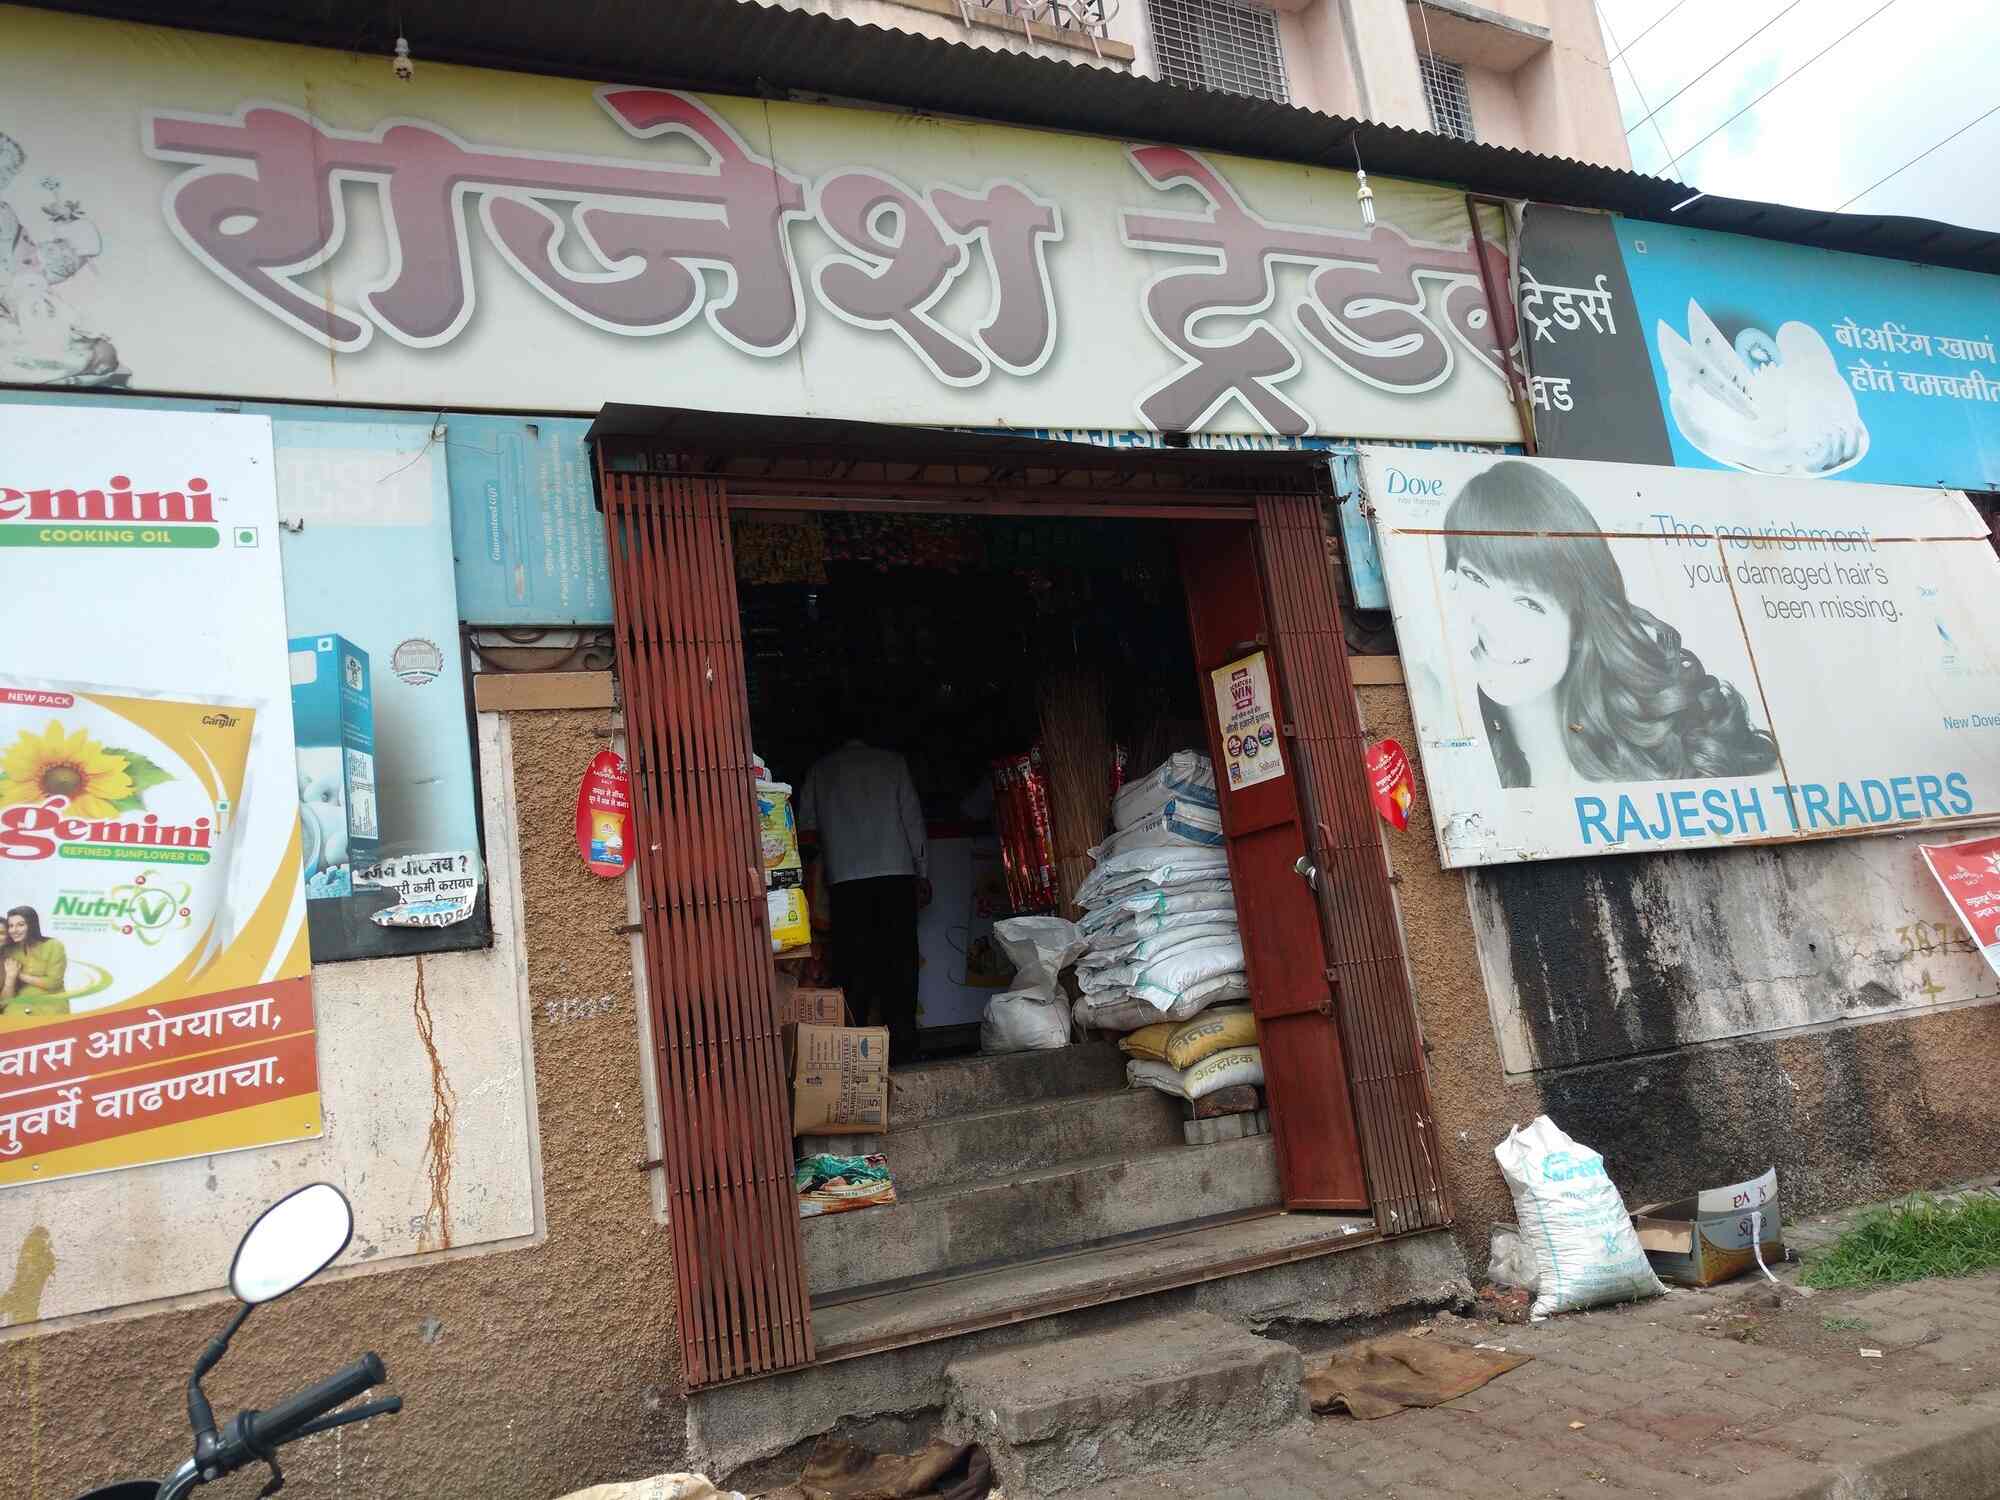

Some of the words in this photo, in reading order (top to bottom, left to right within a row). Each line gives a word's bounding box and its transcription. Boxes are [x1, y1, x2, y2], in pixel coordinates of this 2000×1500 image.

[150, 87, 1060, 384] राजेश
[1848, 358, 1895, 392] होतं
[1385, 467, 1443, 497] Dove
[39, 529, 134, 543] COOKING
[141, 530, 172, 543] OIL
[1650, 514, 1709, 548] The
[1714, 520, 1877, 552] nourishment
[1736, 561, 1832, 590] damaged
[1834, 563, 1889, 585] hair's
[1761, 595, 1814, 619] been
[1819, 595, 1904, 622] missing.
[7, 692, 35, 703] NEW
[38, 694, 71, 705] PACK
[202, 713, 239, 728] Cargill
[1943, 716, 1969, 729] New
[1574, 787, 1767, 844] RAJESH
[1772, 772, 1974, 831] TRADERS
[0, 798, 212, 861] gemini
[63, 846, 112, 858] REFINED
[115, 848, 186, 861] SUNFLOWER
[188, 851, 207, 863] OIL
[52, 896, 168, 925] Nutri-V
[85, 998, 281, 1057] आरोग्याचा,
[92, 1056, 286, 1119] वाढण्याचा.
